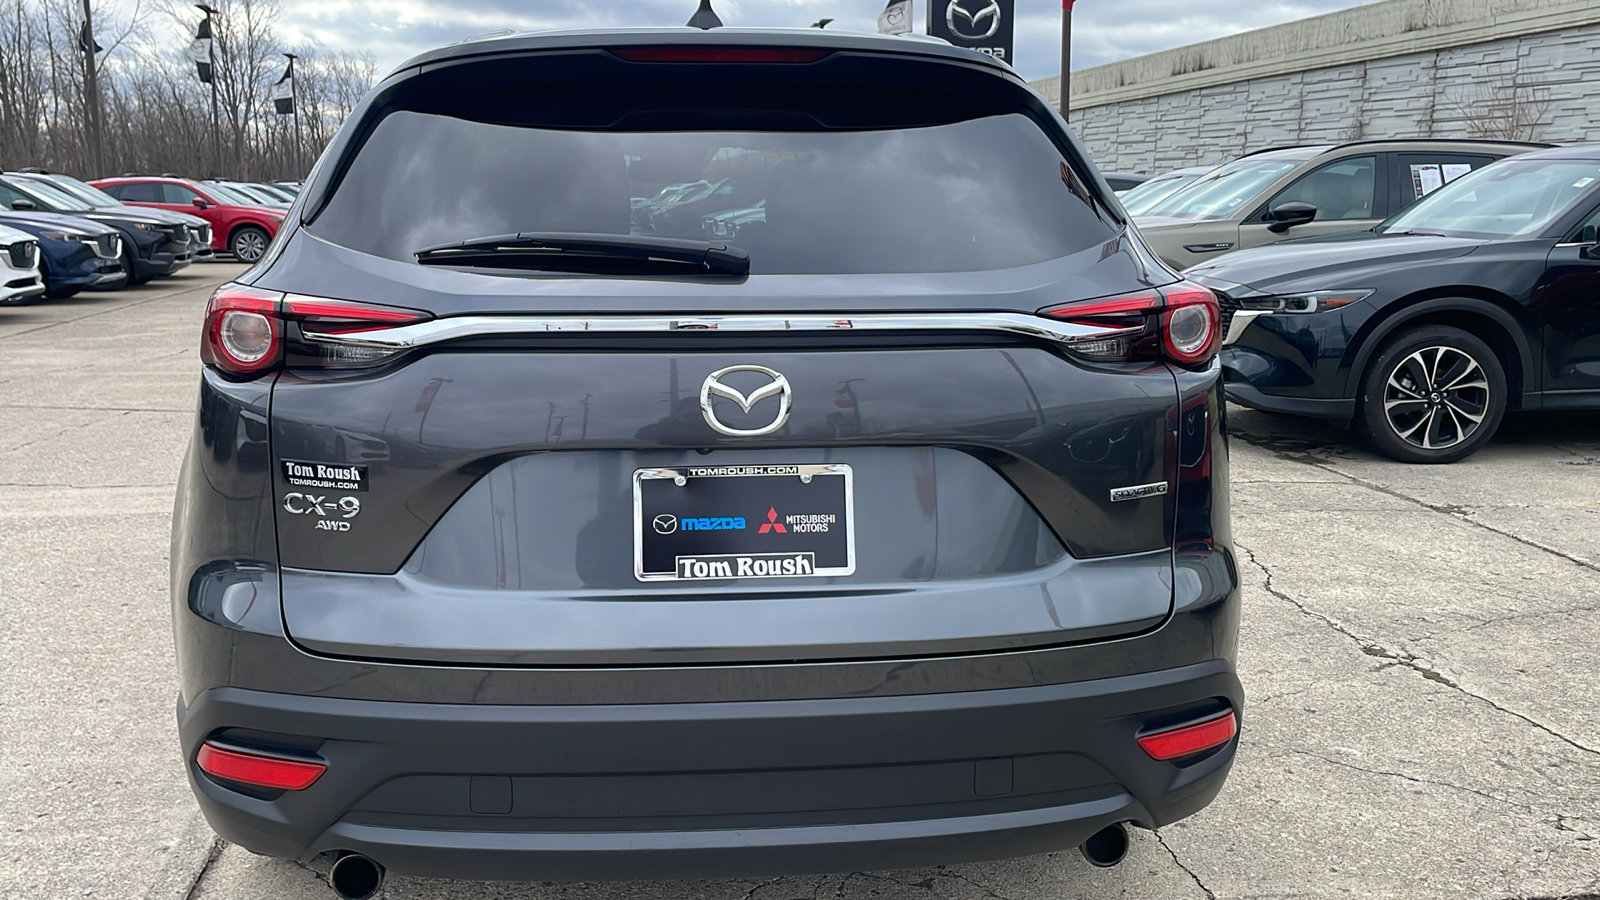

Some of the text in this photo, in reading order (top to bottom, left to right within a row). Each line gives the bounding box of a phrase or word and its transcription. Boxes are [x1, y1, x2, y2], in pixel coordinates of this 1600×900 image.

[286, 462, 361, 481] Tom Roush
[689, 466, 798, 477] TOMROUSH.COM
[289, 477, 359, 490] TOMROUSH.COM
[283, 492, 361, 519] CX-9
[681, 516, 746, 532] mazda
[786, 514, 836, 524] MITSUBISHI
[315, 520, 351, 532] AWD
[793, 523, 829, 533] MOTORS
[679, 554, 812, 578] Tom Roush
